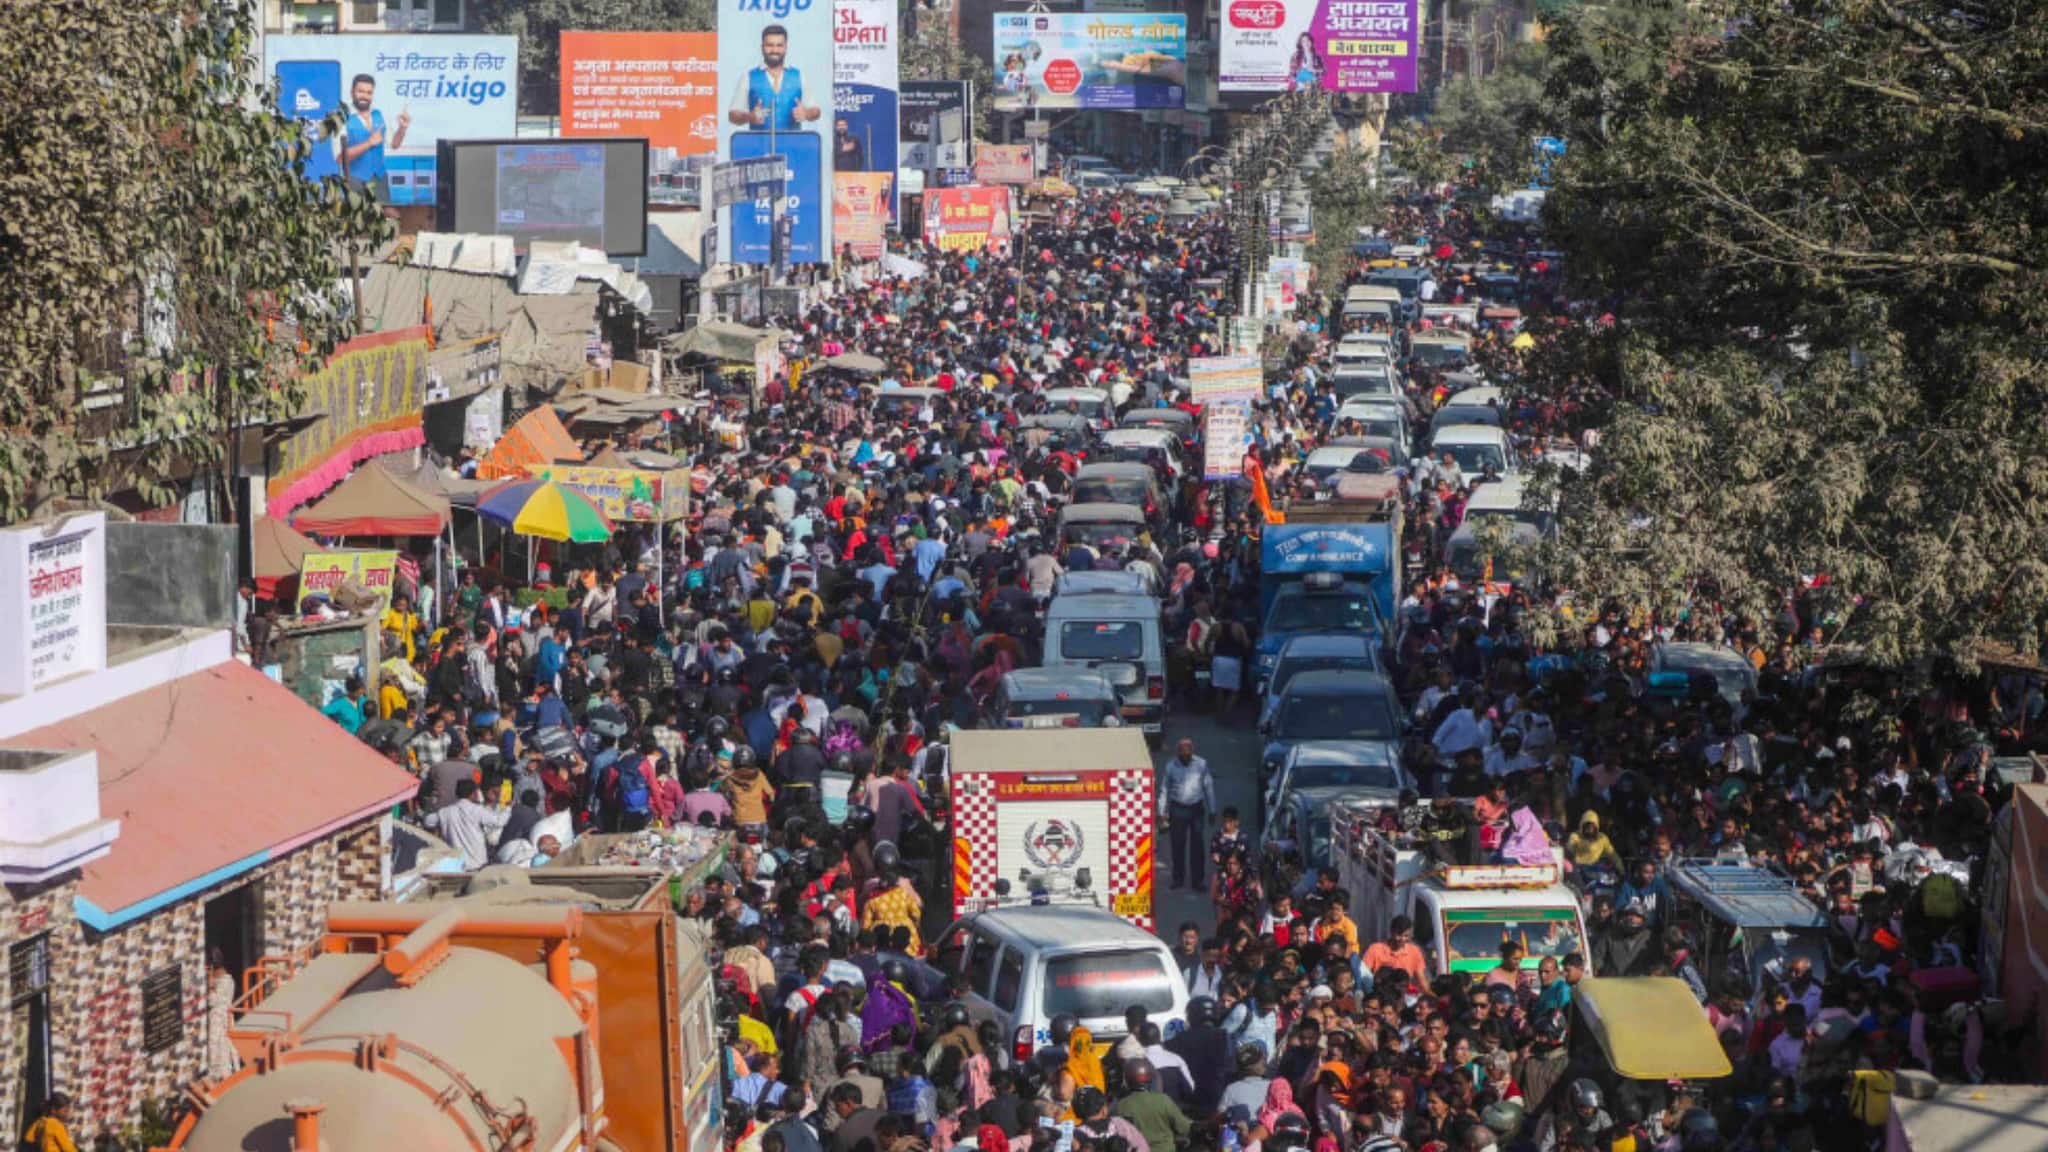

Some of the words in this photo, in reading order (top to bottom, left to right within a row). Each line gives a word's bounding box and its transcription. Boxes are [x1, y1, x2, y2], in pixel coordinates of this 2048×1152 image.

[1326, 16, 1409, 32] अध्ययन
[376, 53, 399, 71] ट्रेन
[404, 52, 447, 71] टिकट
[452, 53, 470, 71] के
[473, 52, 506, 71] लिए
[395, 79, 432, 98] बस
[436, 74, 506, 105] ixigo
